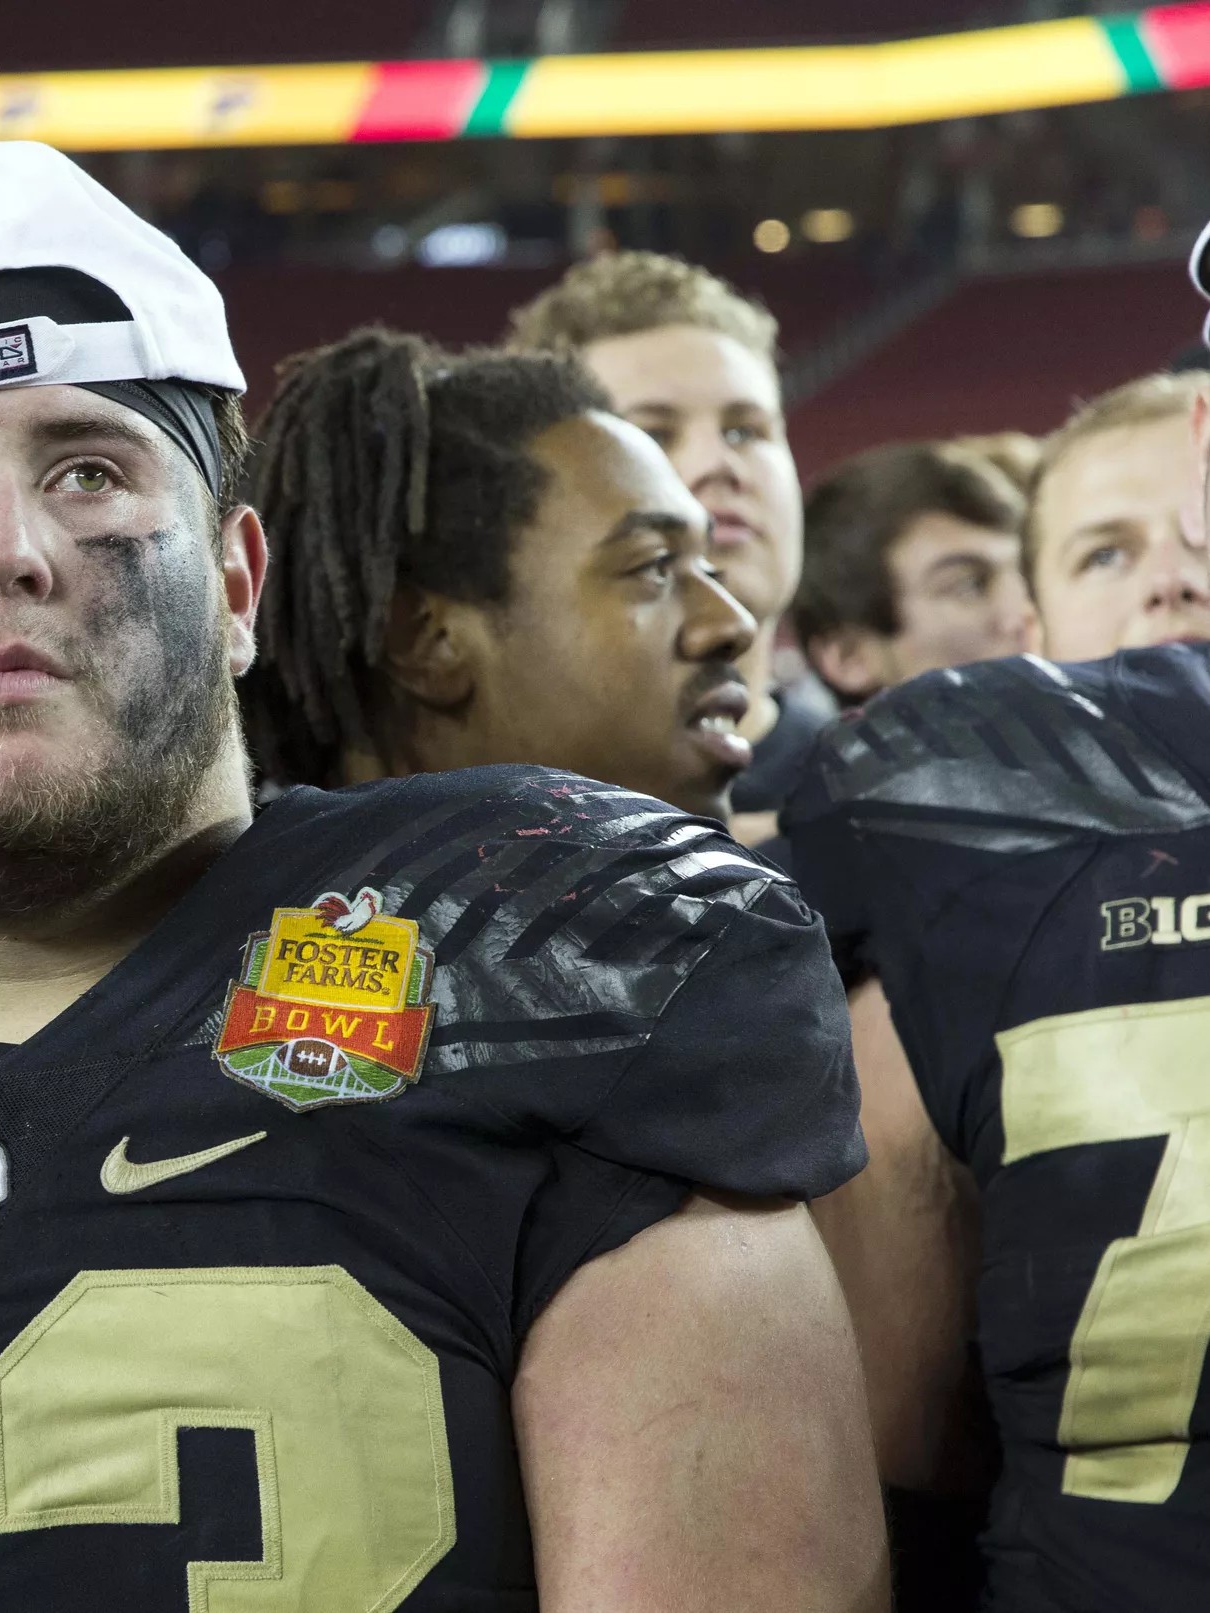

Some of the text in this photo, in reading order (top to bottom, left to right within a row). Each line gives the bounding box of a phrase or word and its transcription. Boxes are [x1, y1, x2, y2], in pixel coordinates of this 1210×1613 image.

[276, 938, 400, 974] FOSTER
[283, 962, 384, 993] FARMS
[249, 1005, 395, 1051] BOWL
